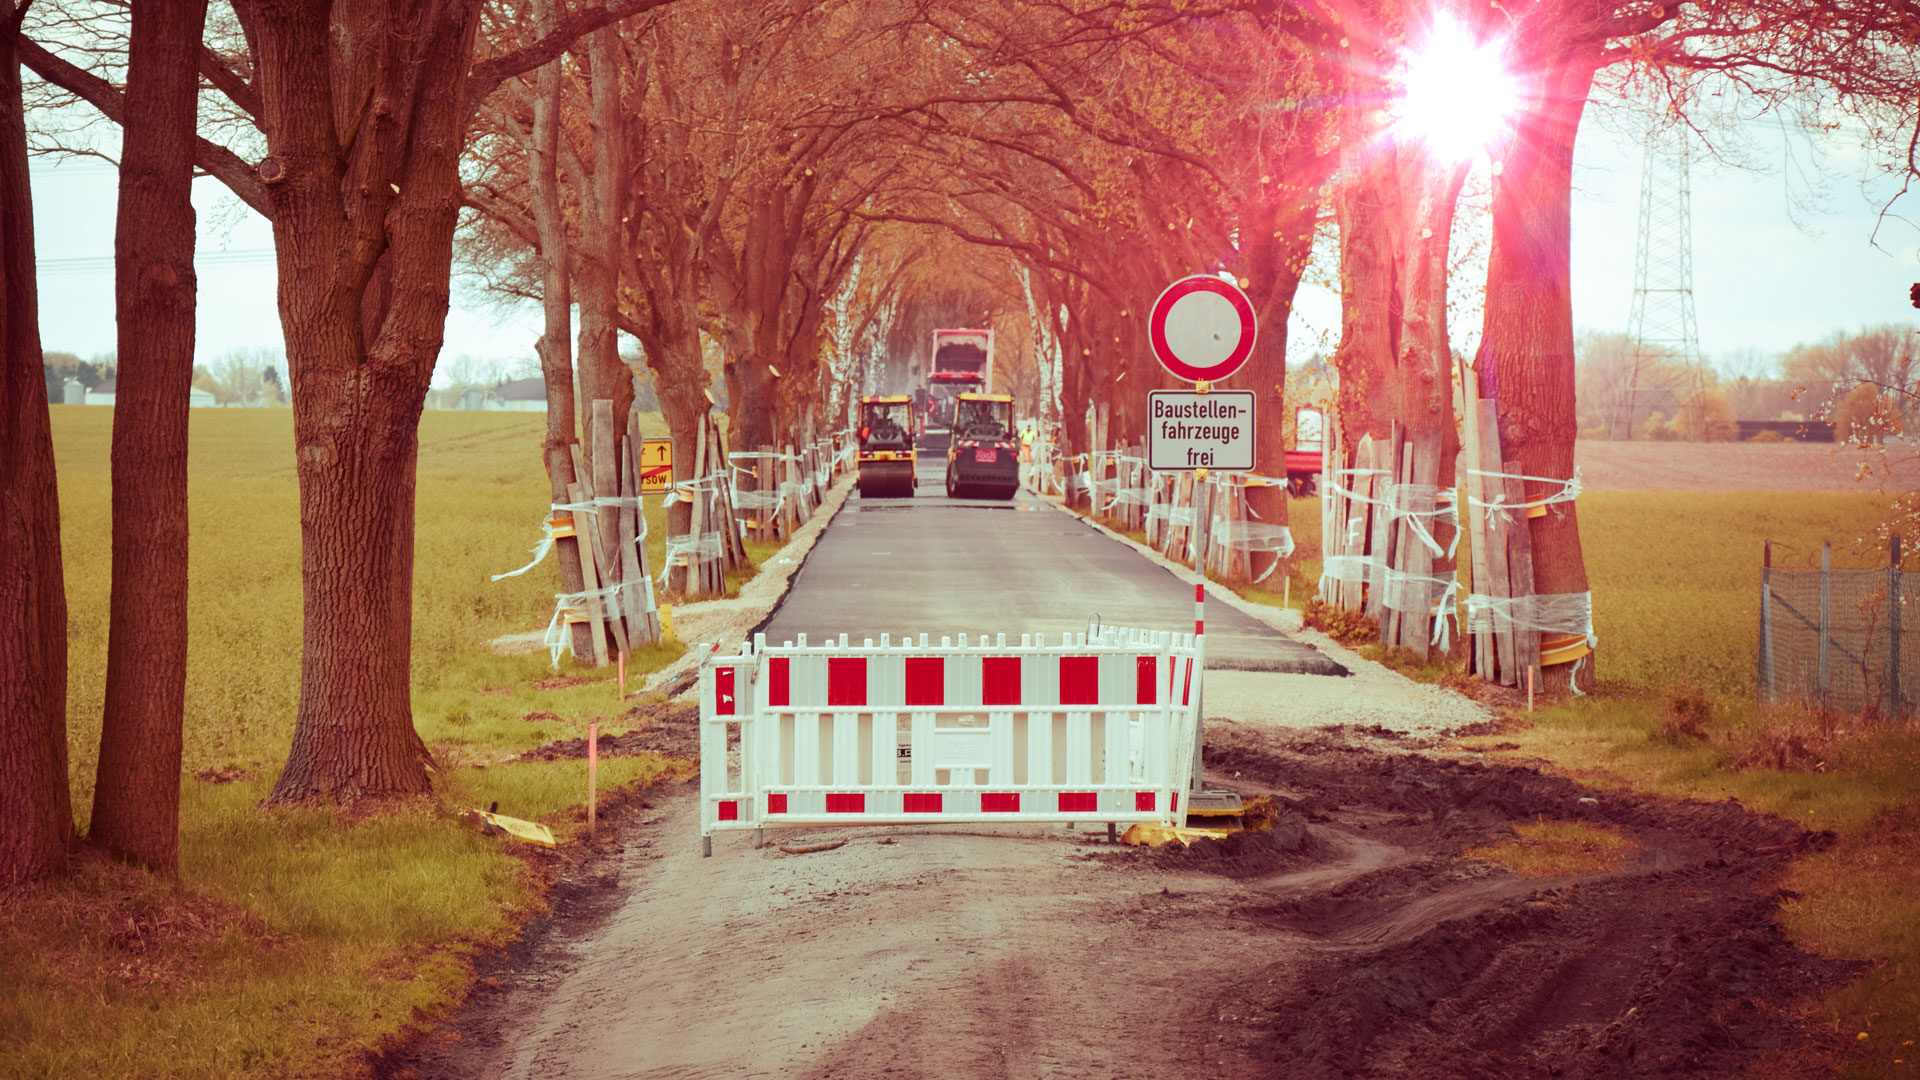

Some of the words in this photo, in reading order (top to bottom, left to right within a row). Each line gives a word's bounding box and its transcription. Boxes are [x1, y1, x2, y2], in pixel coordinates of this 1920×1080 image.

[1155, 400, 1247, 419] Baustellen-
[1161, 421, 1240, 445] fahrzeuge
[1187, 447, 1214, 466] frei
[1348, 517, 1363, 546] F
